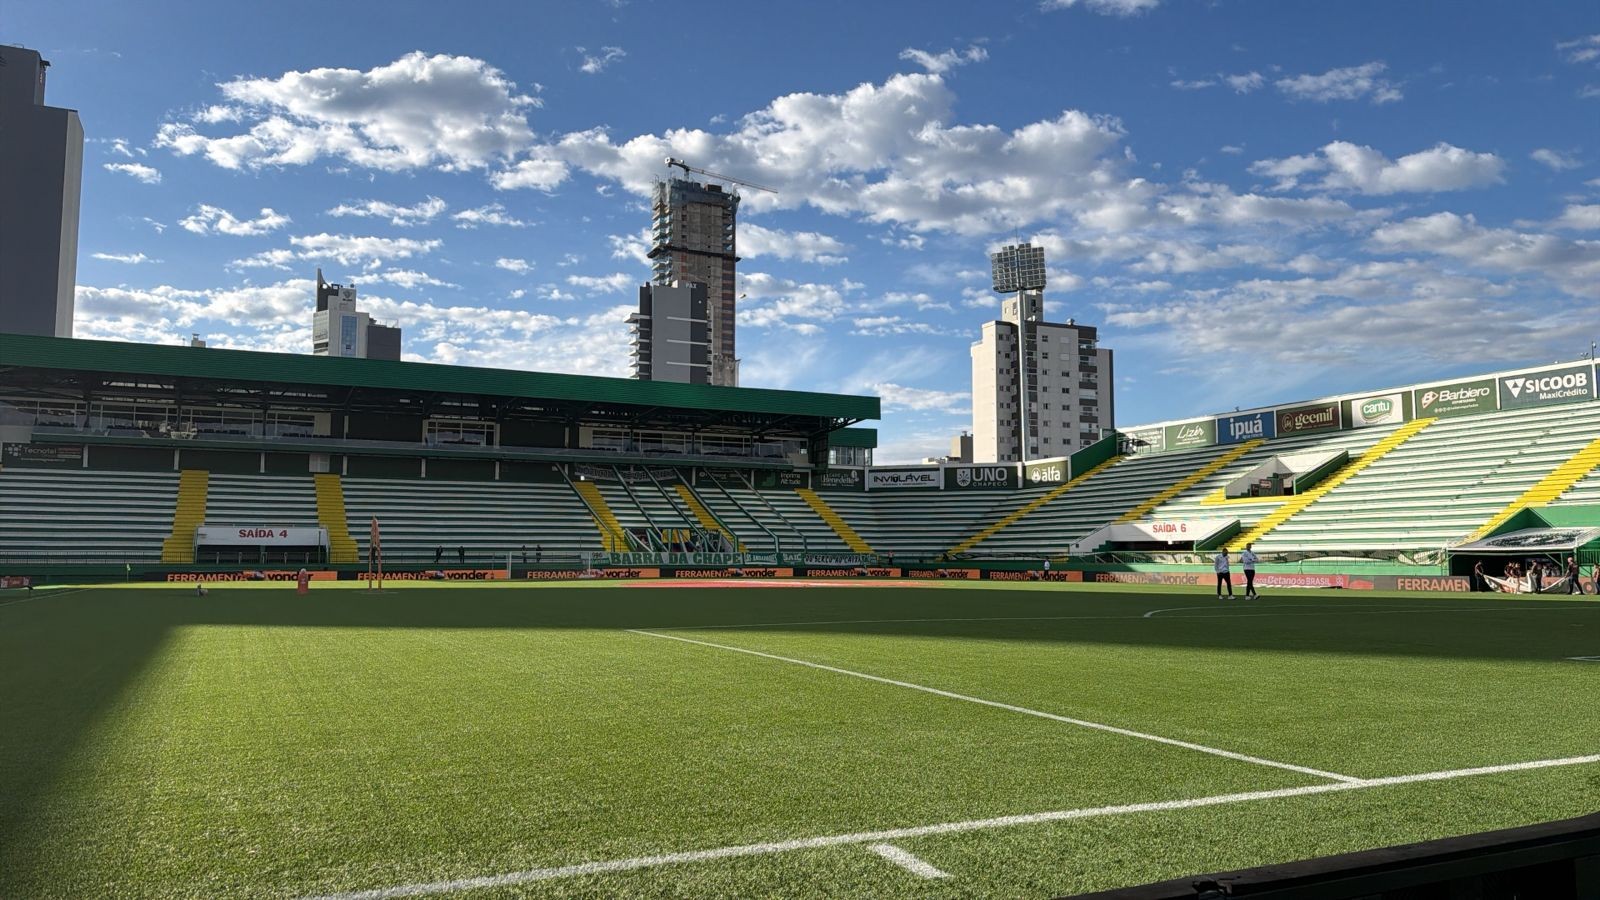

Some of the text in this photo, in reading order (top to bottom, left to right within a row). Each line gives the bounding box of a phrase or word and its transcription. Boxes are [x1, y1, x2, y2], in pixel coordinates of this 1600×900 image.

[1525, 373, 1587, 393] SICOOB
[1439, 387, 1490, 402] Barbiero
[1539, 389, 1588, 400] MaxiCrédito
[1363, 401, 1390, 414] cantu
[1295, 407, 1333, 429] geemil
[1229, 414, 1263, 439] ipuá
[972, 467, 1007, 481] UNO
[239, 527, 288, 538] SAÍDA 4
[1152, 523, 1187, 533] SAÍDA 6
[610, 552, 663, 565] BARRA
[668, 553, 689, 564] DA
[694, 552, 742, 564] CHAPE
[267, 570, 314, 581] vondr
[448, 570, 488, 580] vonder
[745, 567, 777, 577] vonder
[1162, 572, 1199, 585] vonder
[1268, 575, 1296, 585] Betano
